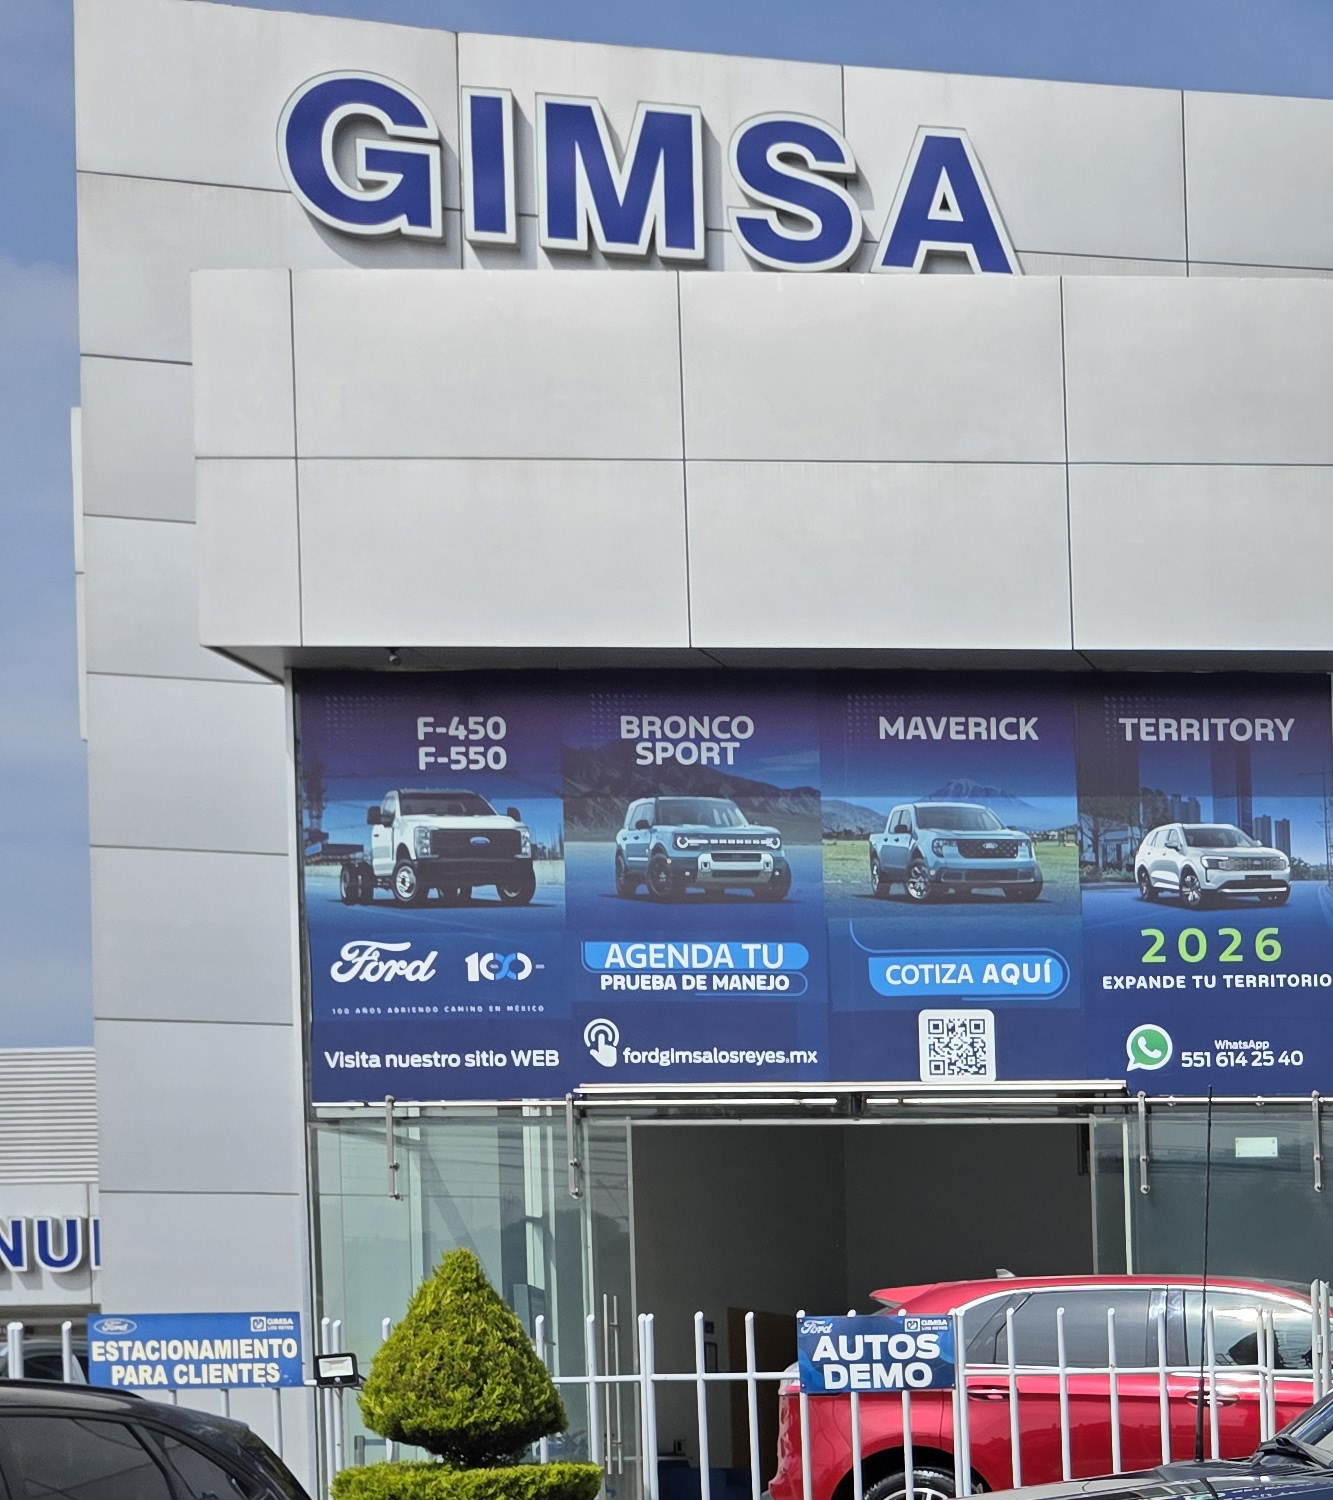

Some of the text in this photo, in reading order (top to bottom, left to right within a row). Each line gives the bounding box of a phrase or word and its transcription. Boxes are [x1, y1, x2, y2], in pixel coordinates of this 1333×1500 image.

[276, 70, 1025, 275] GIMSA
[416, 716, 507, 742] F-450
[619, 716, 755, 740] BRONCO
[878, 717, 1039, 742] MAVERICK
[1118, 718, 1295, 742] TERRITORY
[417, 746, 507, 770] F-550
[634, 741, 740, 766] SPORT
[604, 943, 784, 969] AGENDA TU
[1140, 928, 1283, 963] 2026
[330, 940, 438, 983] Ford
[885, 958, 1051, 987] COTIZA AQUÍ
[601, 974, 789, 991] PRUEBA DE MANEJO
[1102, 973, 1332, 990] EXPANDE TU TERRITORIO
[622, 1047, 817, 1066] fordgimsalosreyes.mx
[1214, 1040, 1269, 1050] WhatsApp
[324, 1050, 559, 1068] Visita nuestro sitio WEB
[1181, 1050, 1303, 1067] 551 614 25 40
[102, 1321, 128, 1331] Ford
[801, 1320, 833, 1334] Ford
[91, 1338, 298, 1362] ESTACIONAMIENTO
[812, 1334, 941, 1361] AUTOS
[111, 1363, 281, 1386] PARA CLIENTES
[823, 1362, 933, 1389] DEMO
